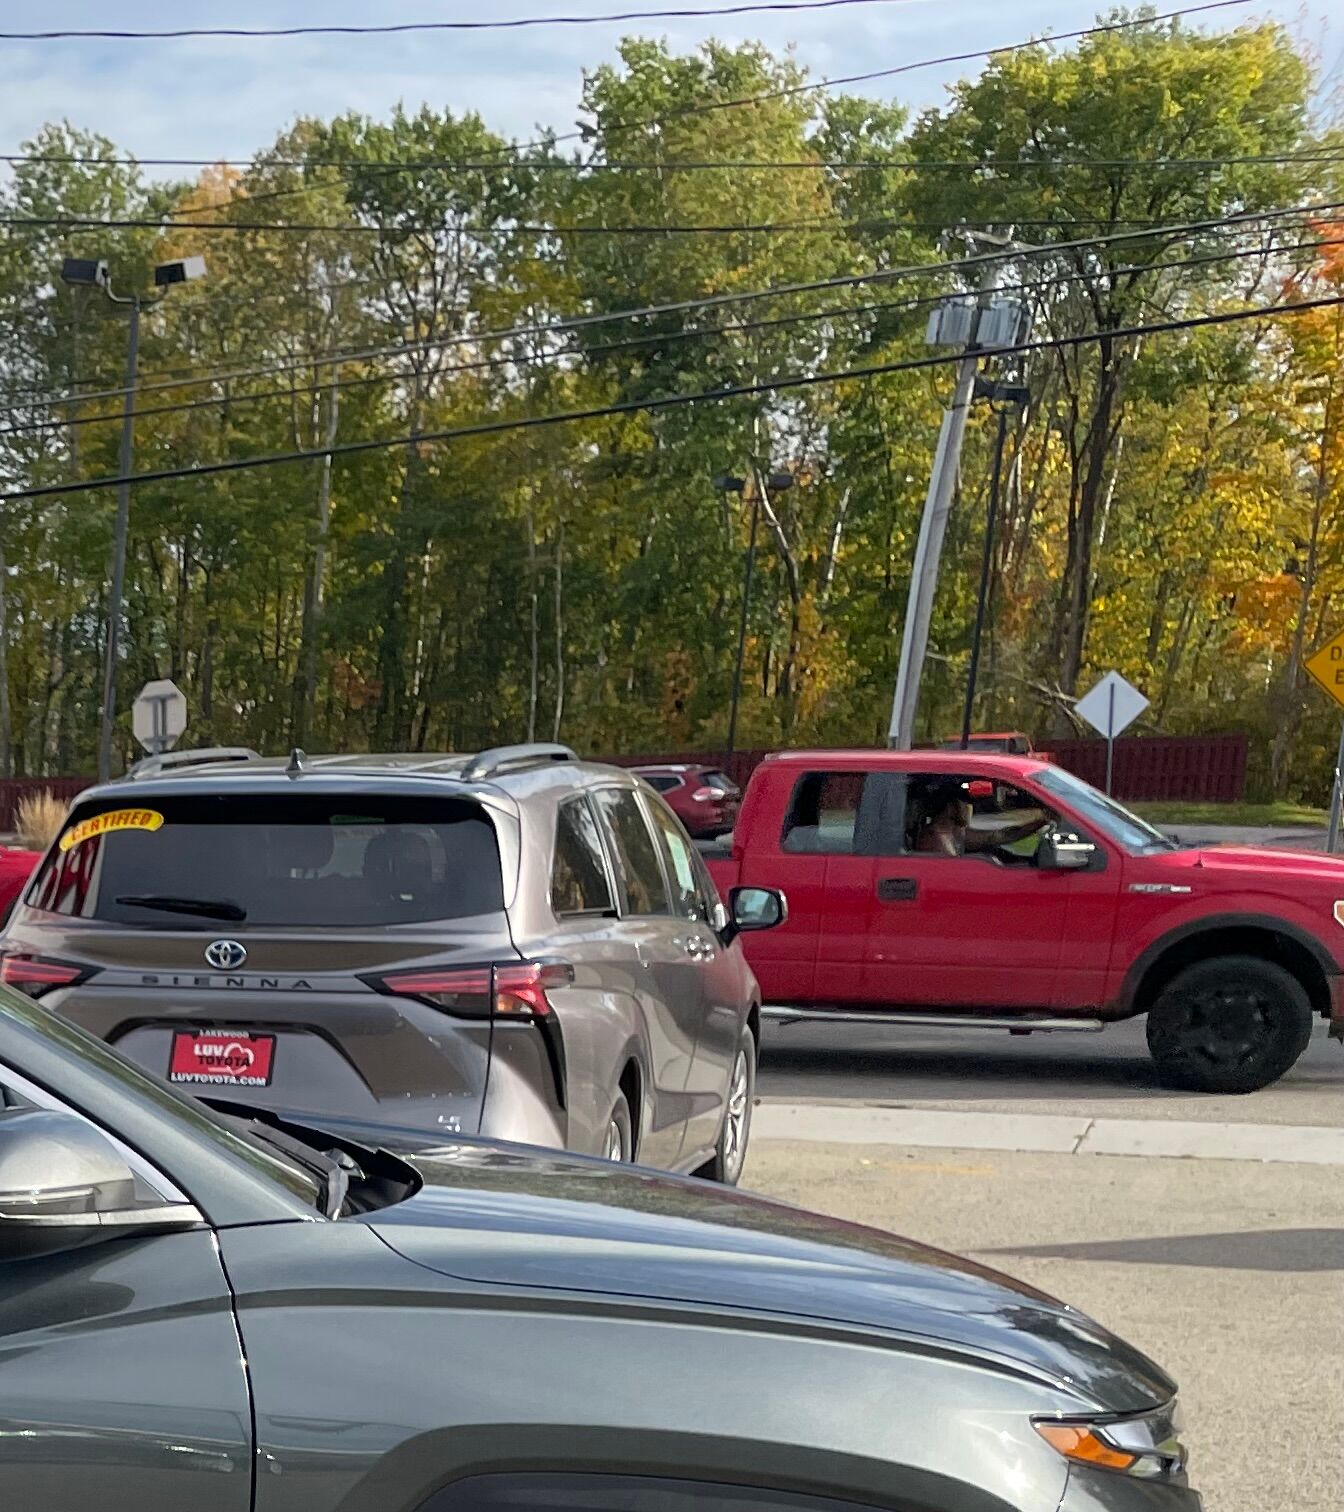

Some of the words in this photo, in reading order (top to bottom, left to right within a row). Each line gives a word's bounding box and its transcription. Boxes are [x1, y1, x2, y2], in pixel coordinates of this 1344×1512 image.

[72, 811, 153, 841] CERTIFIED
[142, 975, 312, 990] SIENNA
[199, 1029, 250, 1039] LAKEWOOD
[194, 1043, 225, 1057] LUV
[198, 1054, 252, 1068] TOYOTA
[171, 1071, 267, 1087] LUVTOYOTA.COM
